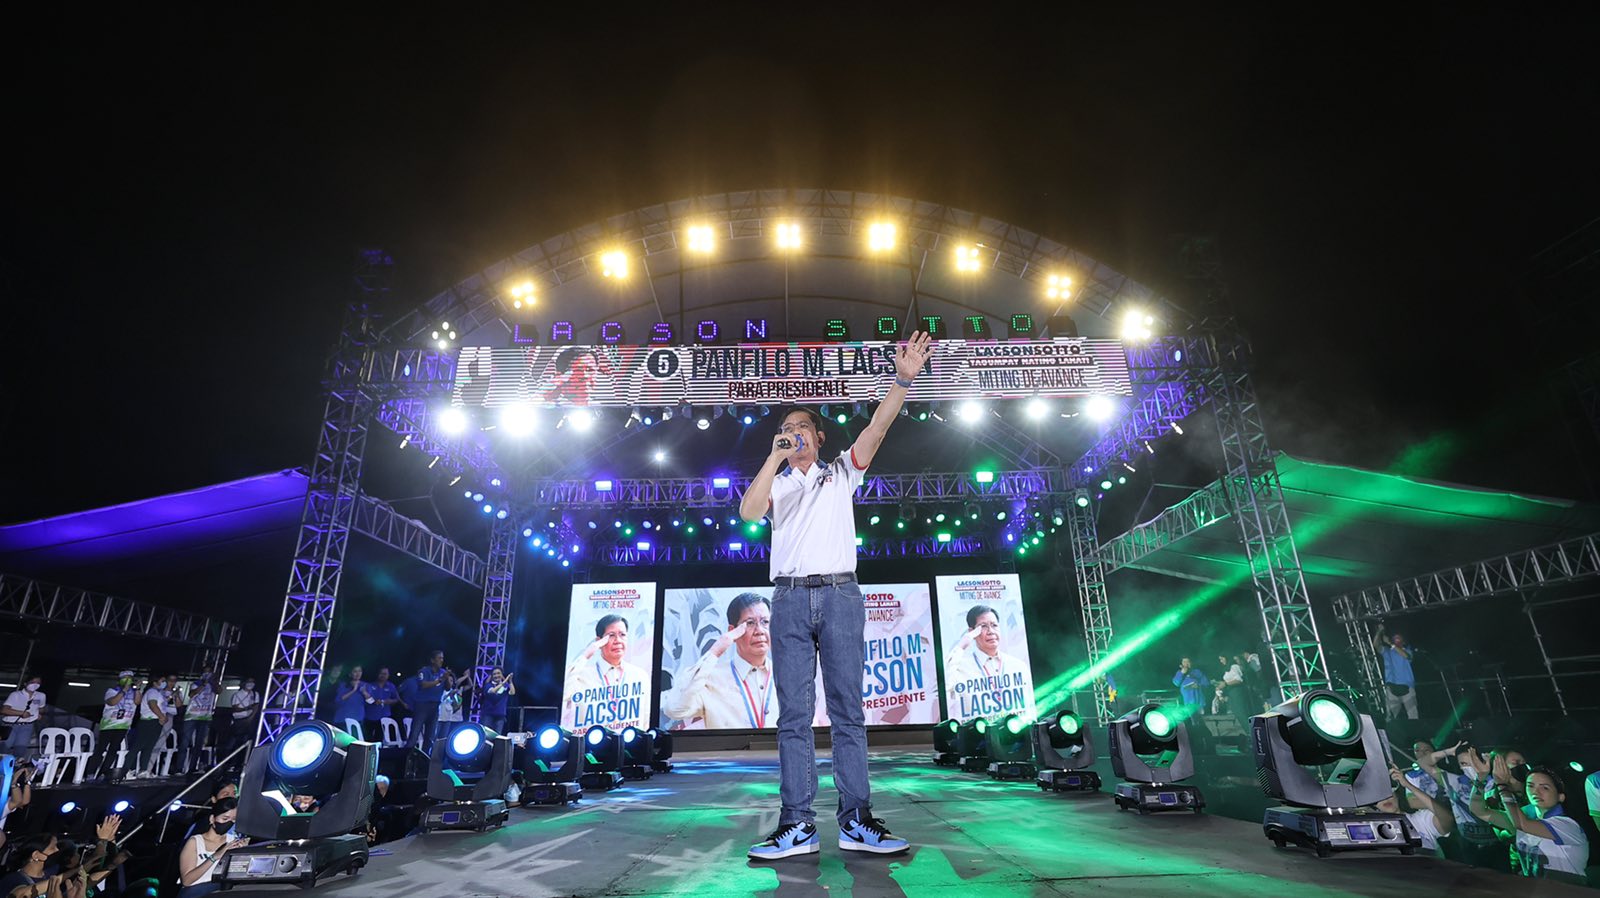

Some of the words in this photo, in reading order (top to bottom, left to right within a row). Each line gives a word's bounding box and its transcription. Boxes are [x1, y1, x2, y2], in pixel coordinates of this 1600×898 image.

[514, 320, 765, 343] LACSON
[827, 314, 1032, 337] SOTTO
[975, 345, 1081, 356] LACSONSOTTO
[691, 348, 790, 379] PANFILO
[979, 370, 1020, 389] MITING
[1022, 369, 1039, 388] DE
[1041, 368, 1087, 388] AVANCE
[728, 381, 763, 399] PARA
[767, 380, 850, 399] PRESIDENTE
[868, 609, 894, 622] AVANCE
[862, 656, 923, 698] CSON
[966, 674, 1011, 694] PANFILO
[584, 683, 629, 703] PANFILO
[960, 687, 1026, 718] LACSON
[575, 697, 641, 728] LACSON
